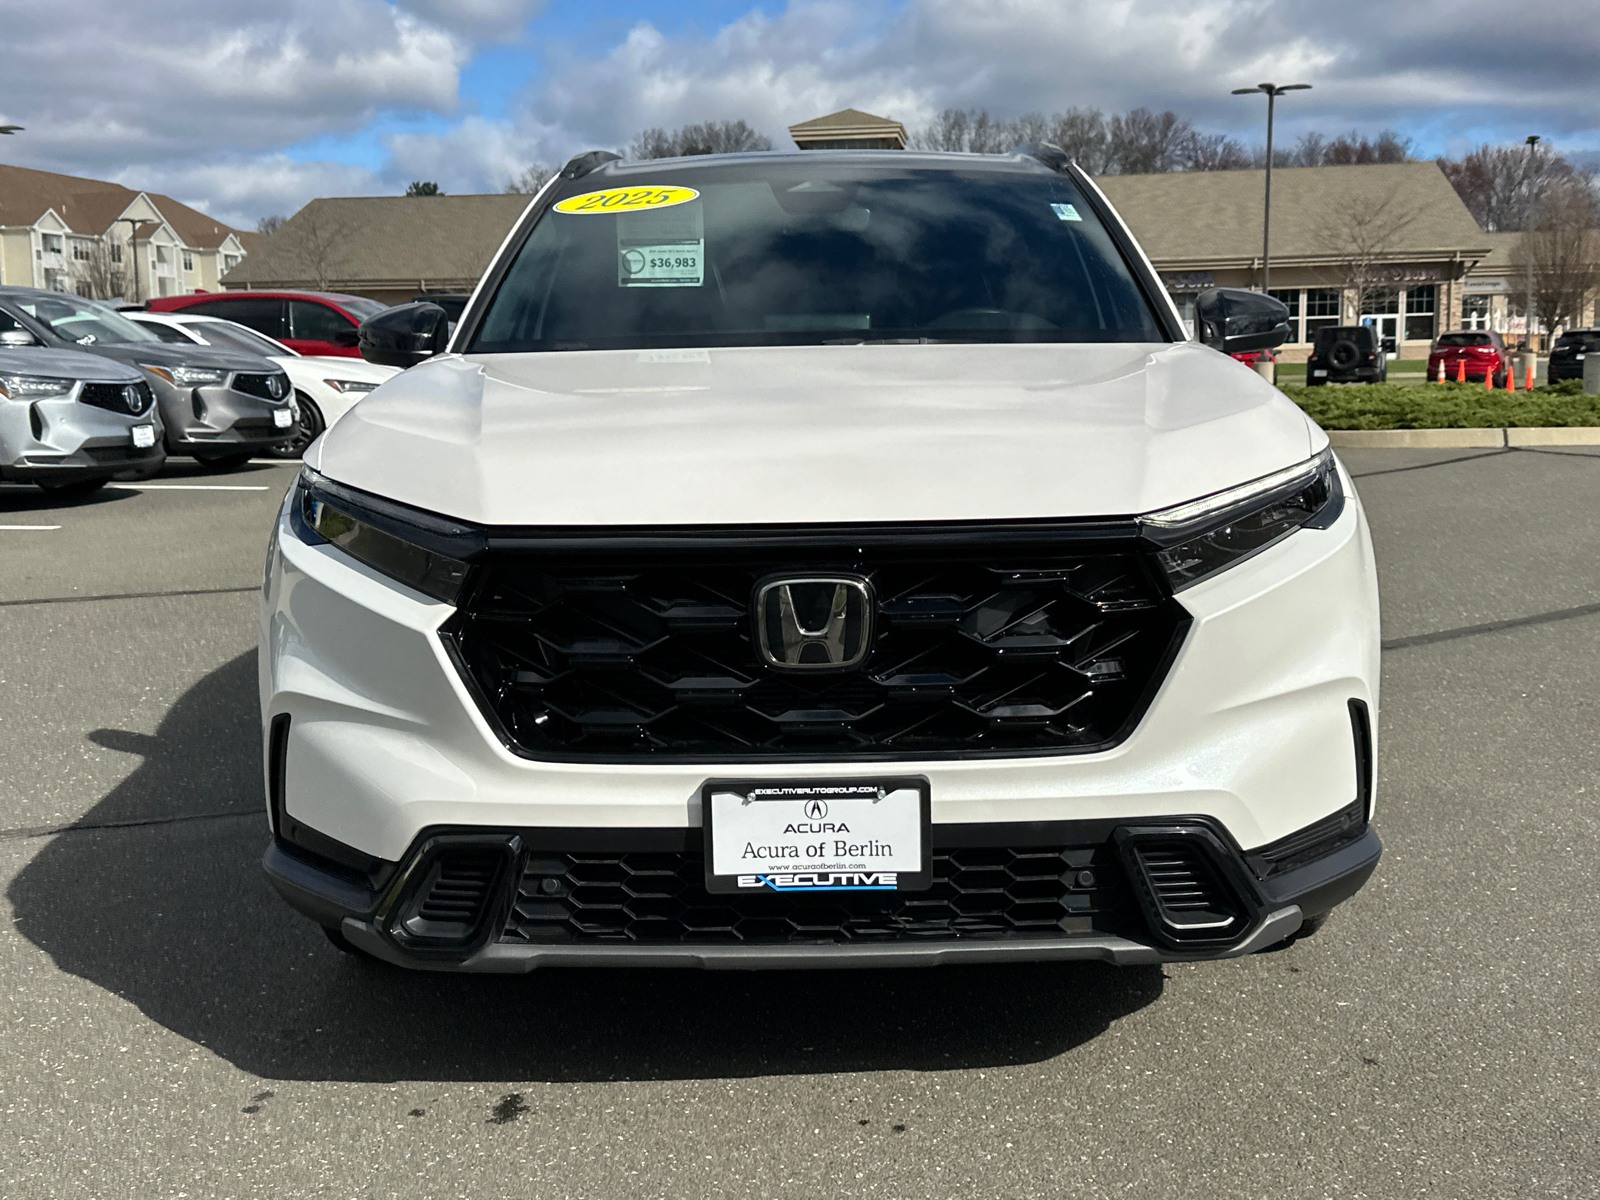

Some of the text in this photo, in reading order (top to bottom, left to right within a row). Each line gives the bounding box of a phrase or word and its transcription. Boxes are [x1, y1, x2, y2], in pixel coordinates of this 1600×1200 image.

[575, 190, 678, 210] 2025
[650, 257, 696, 270] $36,983
[754, 786, 878, 795] EXECUTIVEAUTOGROUP.COM
[783, 822, 851, 834] ACURA
[741, 839, 893, 859] Acura of Berlin
[768, 862, 867, 871] www.acuraofberlin.com
[737, 872, 898, 888] EXECUTIVE
